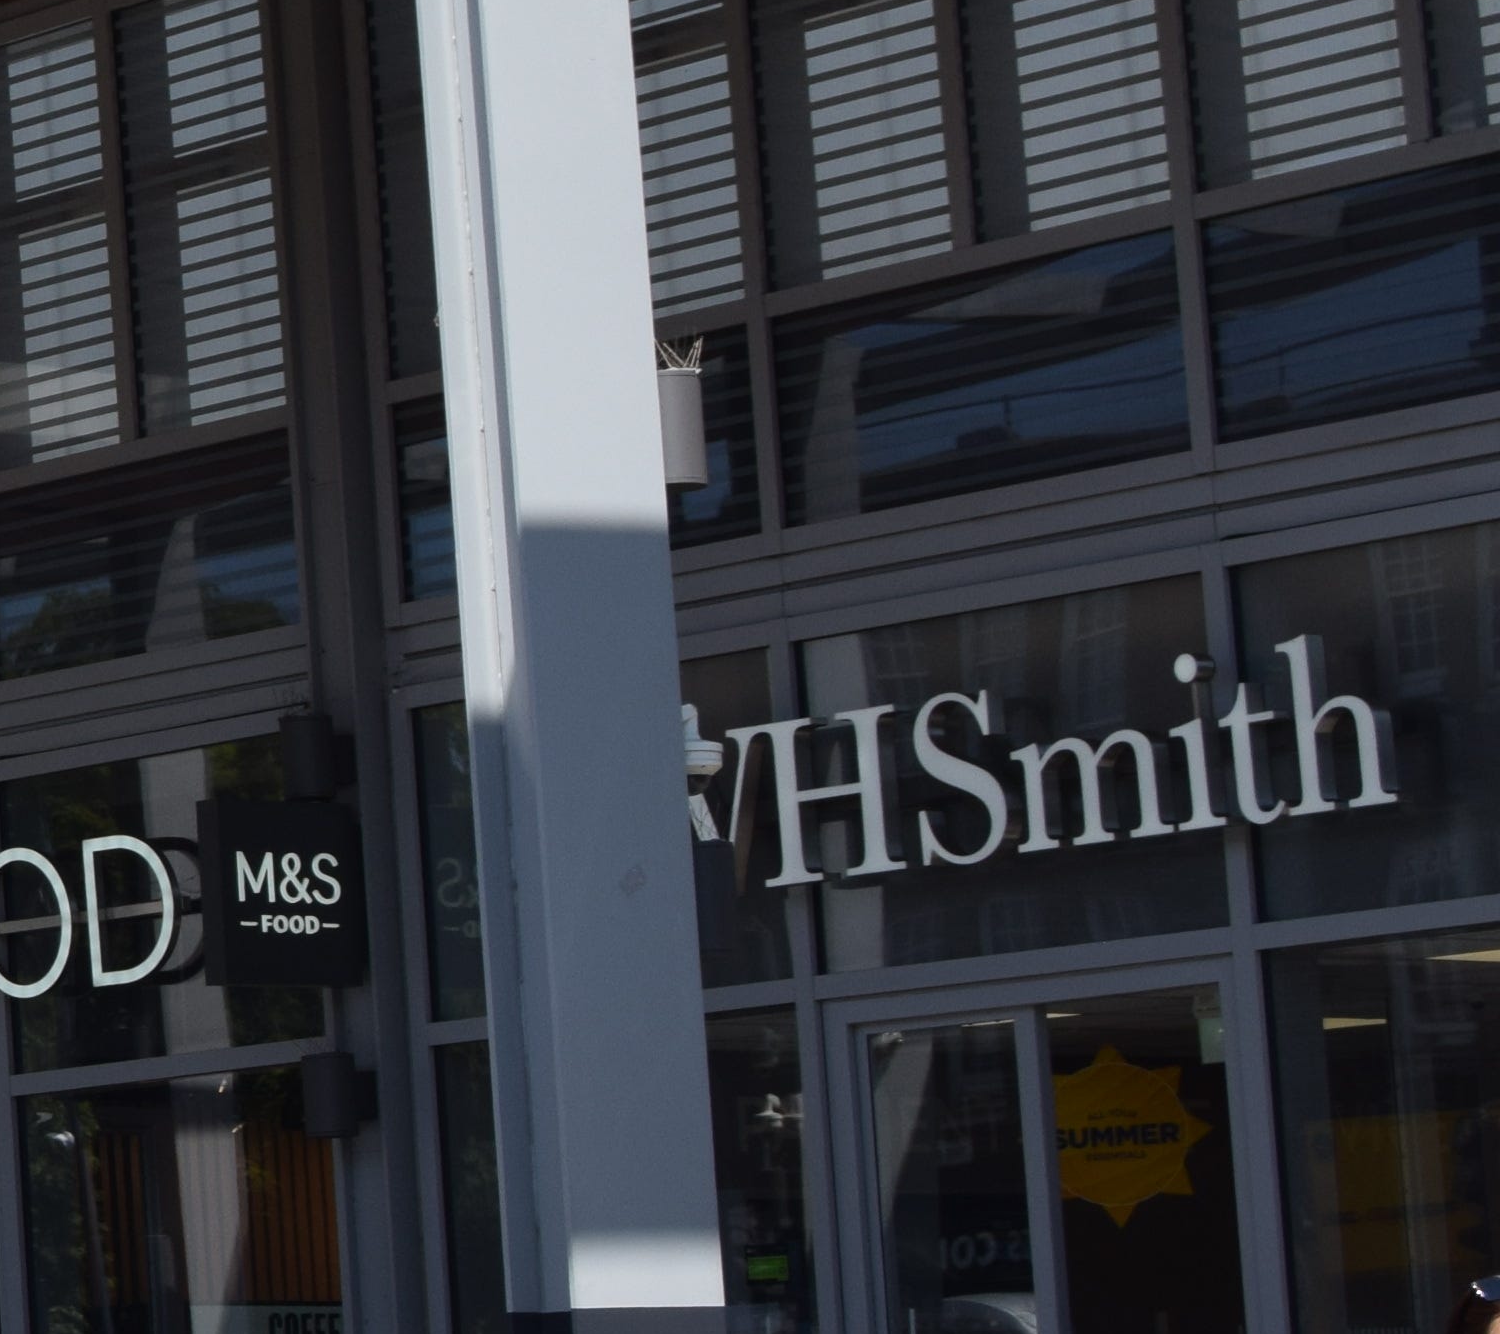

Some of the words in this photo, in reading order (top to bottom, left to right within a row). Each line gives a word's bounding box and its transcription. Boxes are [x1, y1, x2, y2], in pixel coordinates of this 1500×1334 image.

[236, 851, 341, 905] M&S
[261, 914, 321, 936] FOOD
[1056, 1121, 1180, 1149] SUMMER
